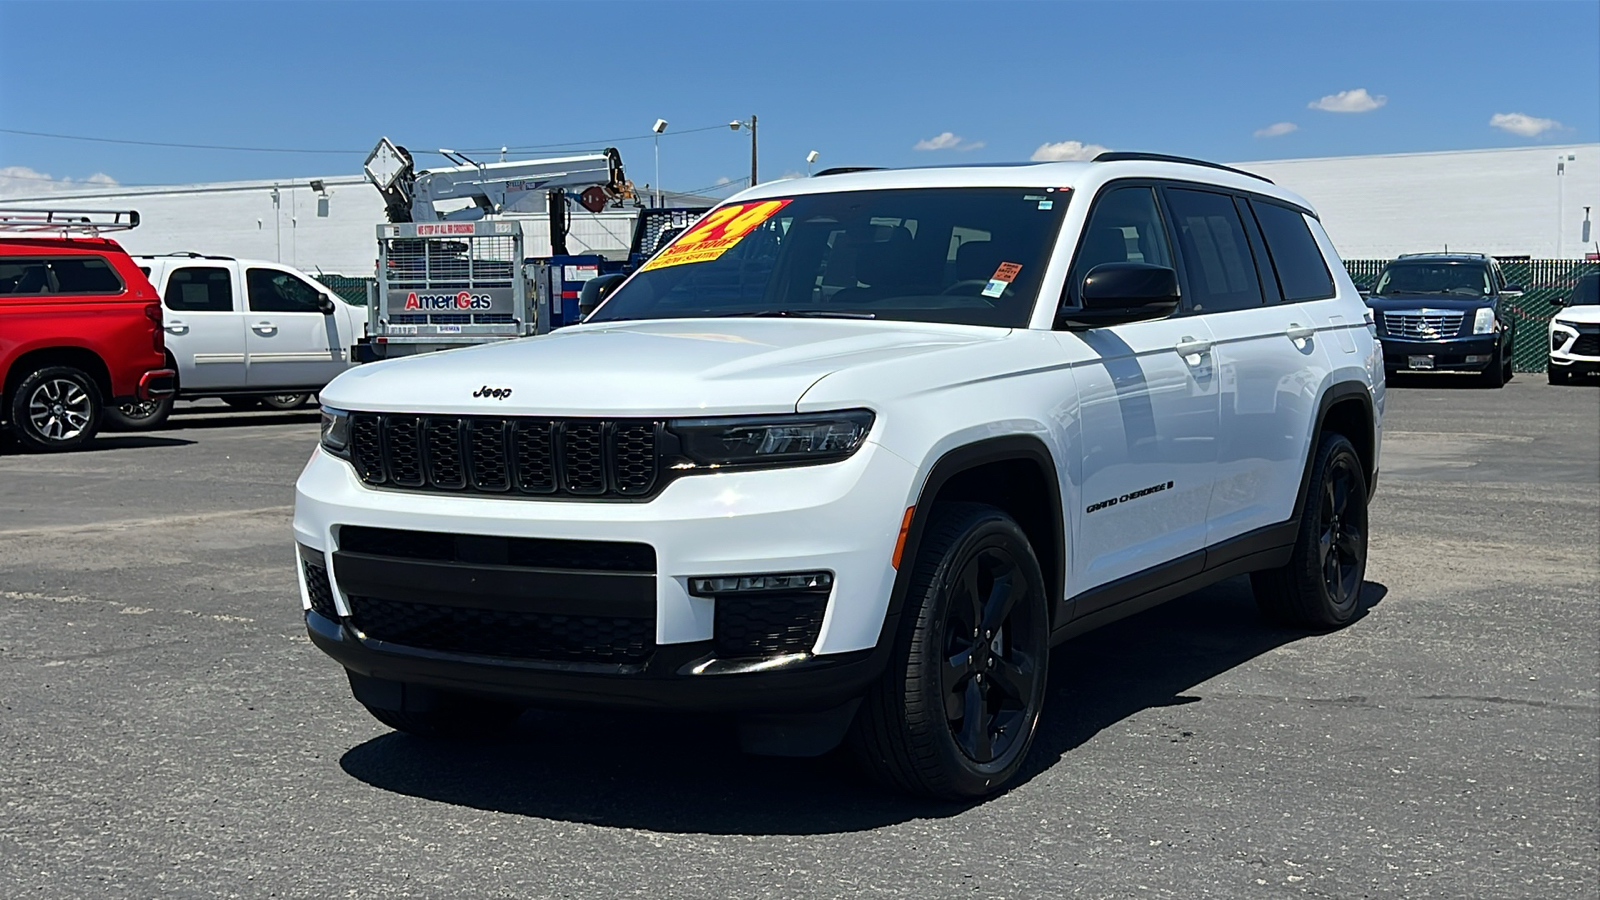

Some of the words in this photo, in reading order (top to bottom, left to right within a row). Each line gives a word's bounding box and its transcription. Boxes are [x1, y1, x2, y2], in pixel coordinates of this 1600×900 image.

[418, 226, 424, 235] WE
[425, 225, 434, 235] STOP
[435, 225, 440, 234] AT
[454, 223, 474, 233] CROSSINGS
[675, 200, 782, 246] 24
[663, 243, 696, 256] SUN
[693, 238, 734, 251] ROOF
[405, 291, 491, 310] AmeriGas
[473, 385, 512, 401] Jeep
[1086, 497, 1118, 513] GRAND
[1119, 483, 1166, 503] CHEROKEE
